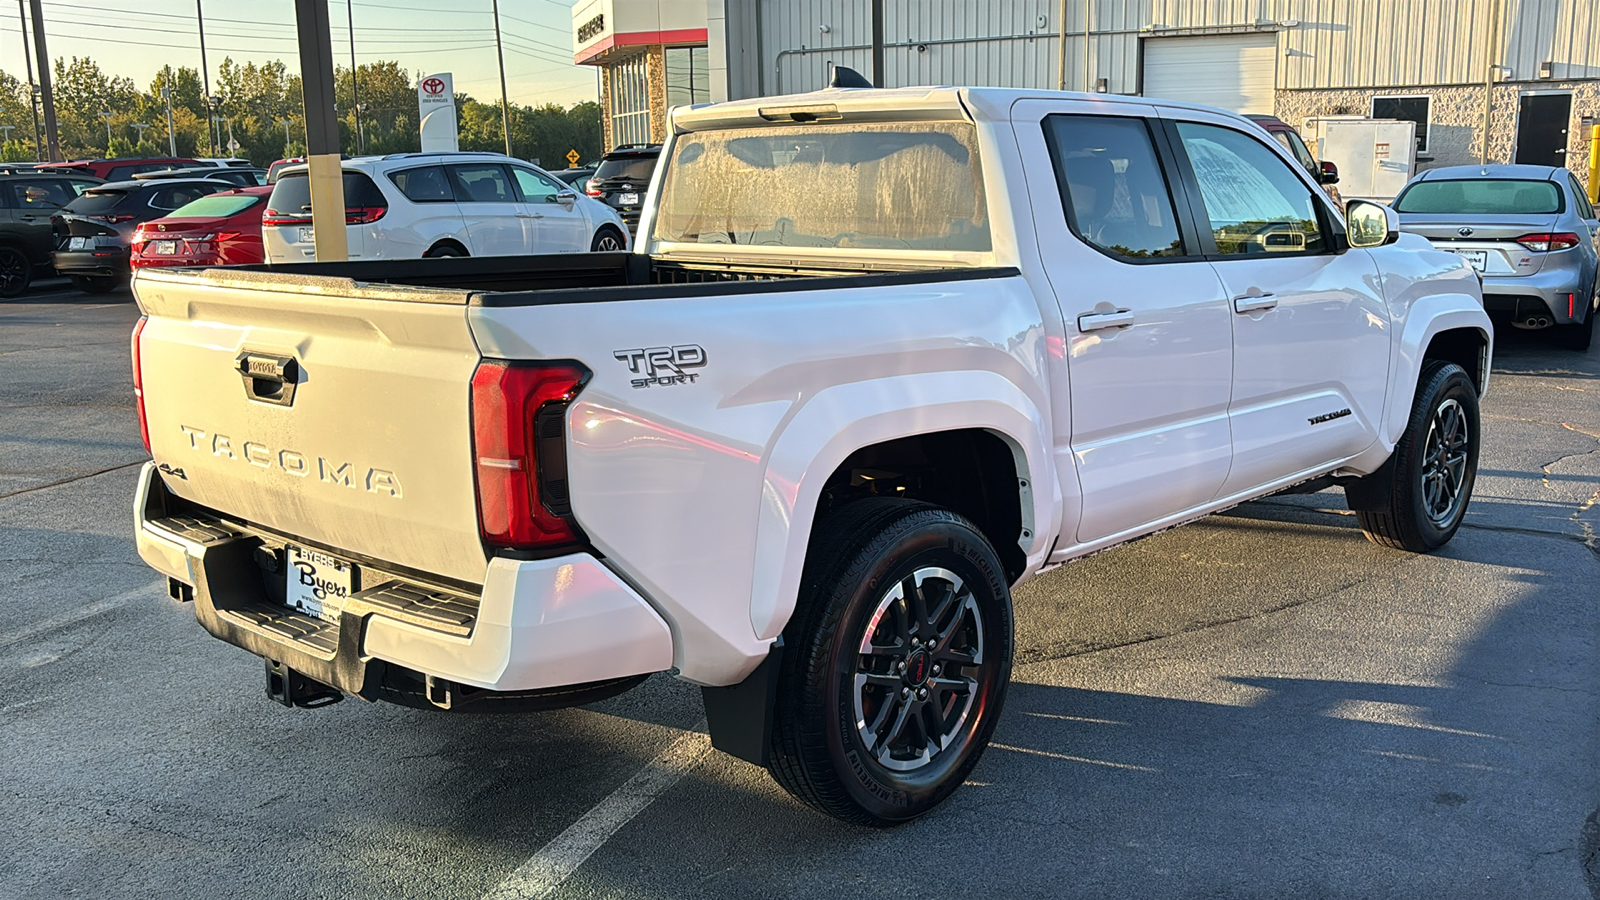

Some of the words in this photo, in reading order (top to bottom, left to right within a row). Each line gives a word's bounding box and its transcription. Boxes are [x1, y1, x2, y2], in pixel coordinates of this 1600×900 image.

[248, 360, 277, 374] TOYOTA
[613, 344, 707, 378] TRD
[630, 373, 699, 389] SPORT
[1307, 407, 1352, 426] TACOMA
[180, 424, 403, 499] TACOMA
[300, 548, 334, 567] BYERS
[966, 547, 1003, 597] MICHELIN
[293, 560, 346, 599] Byers
[848, 752, 891, 802] MICHELIN
